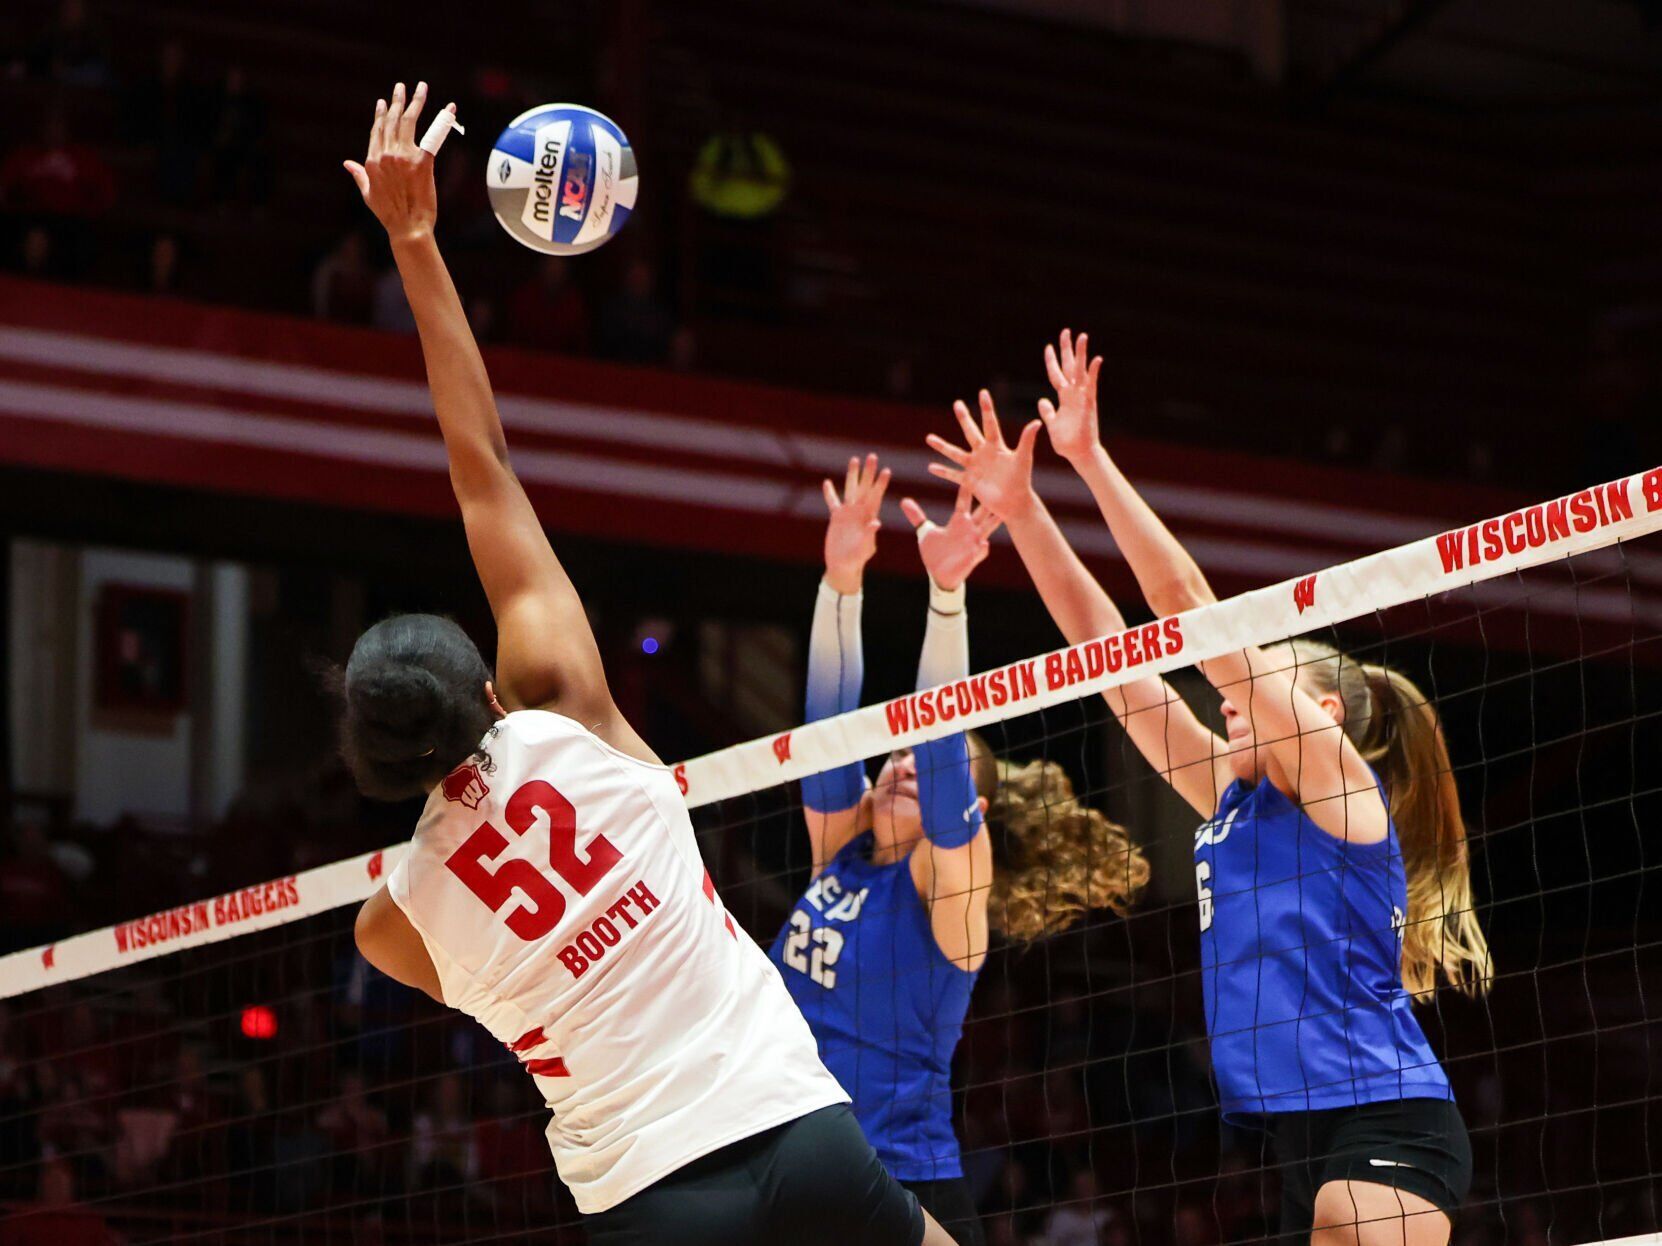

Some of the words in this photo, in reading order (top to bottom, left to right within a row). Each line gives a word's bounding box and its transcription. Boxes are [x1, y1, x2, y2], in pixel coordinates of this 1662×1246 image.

[534, 142, 561, 222] molten
[1436, 479, 1634, 574] WISCONSIN
[885, 661, 1038, 736] WISCONSIN
[1044, 617, 1184, 692] BADGERS
[444, 780, 624, 941] 52
[114, 903, 210, 953] WISCONSIN
[213, 875, 299, 926] BADGERS
[556, 880, 661, 980] BOOTH
[782, 909, 844, 989] 22
